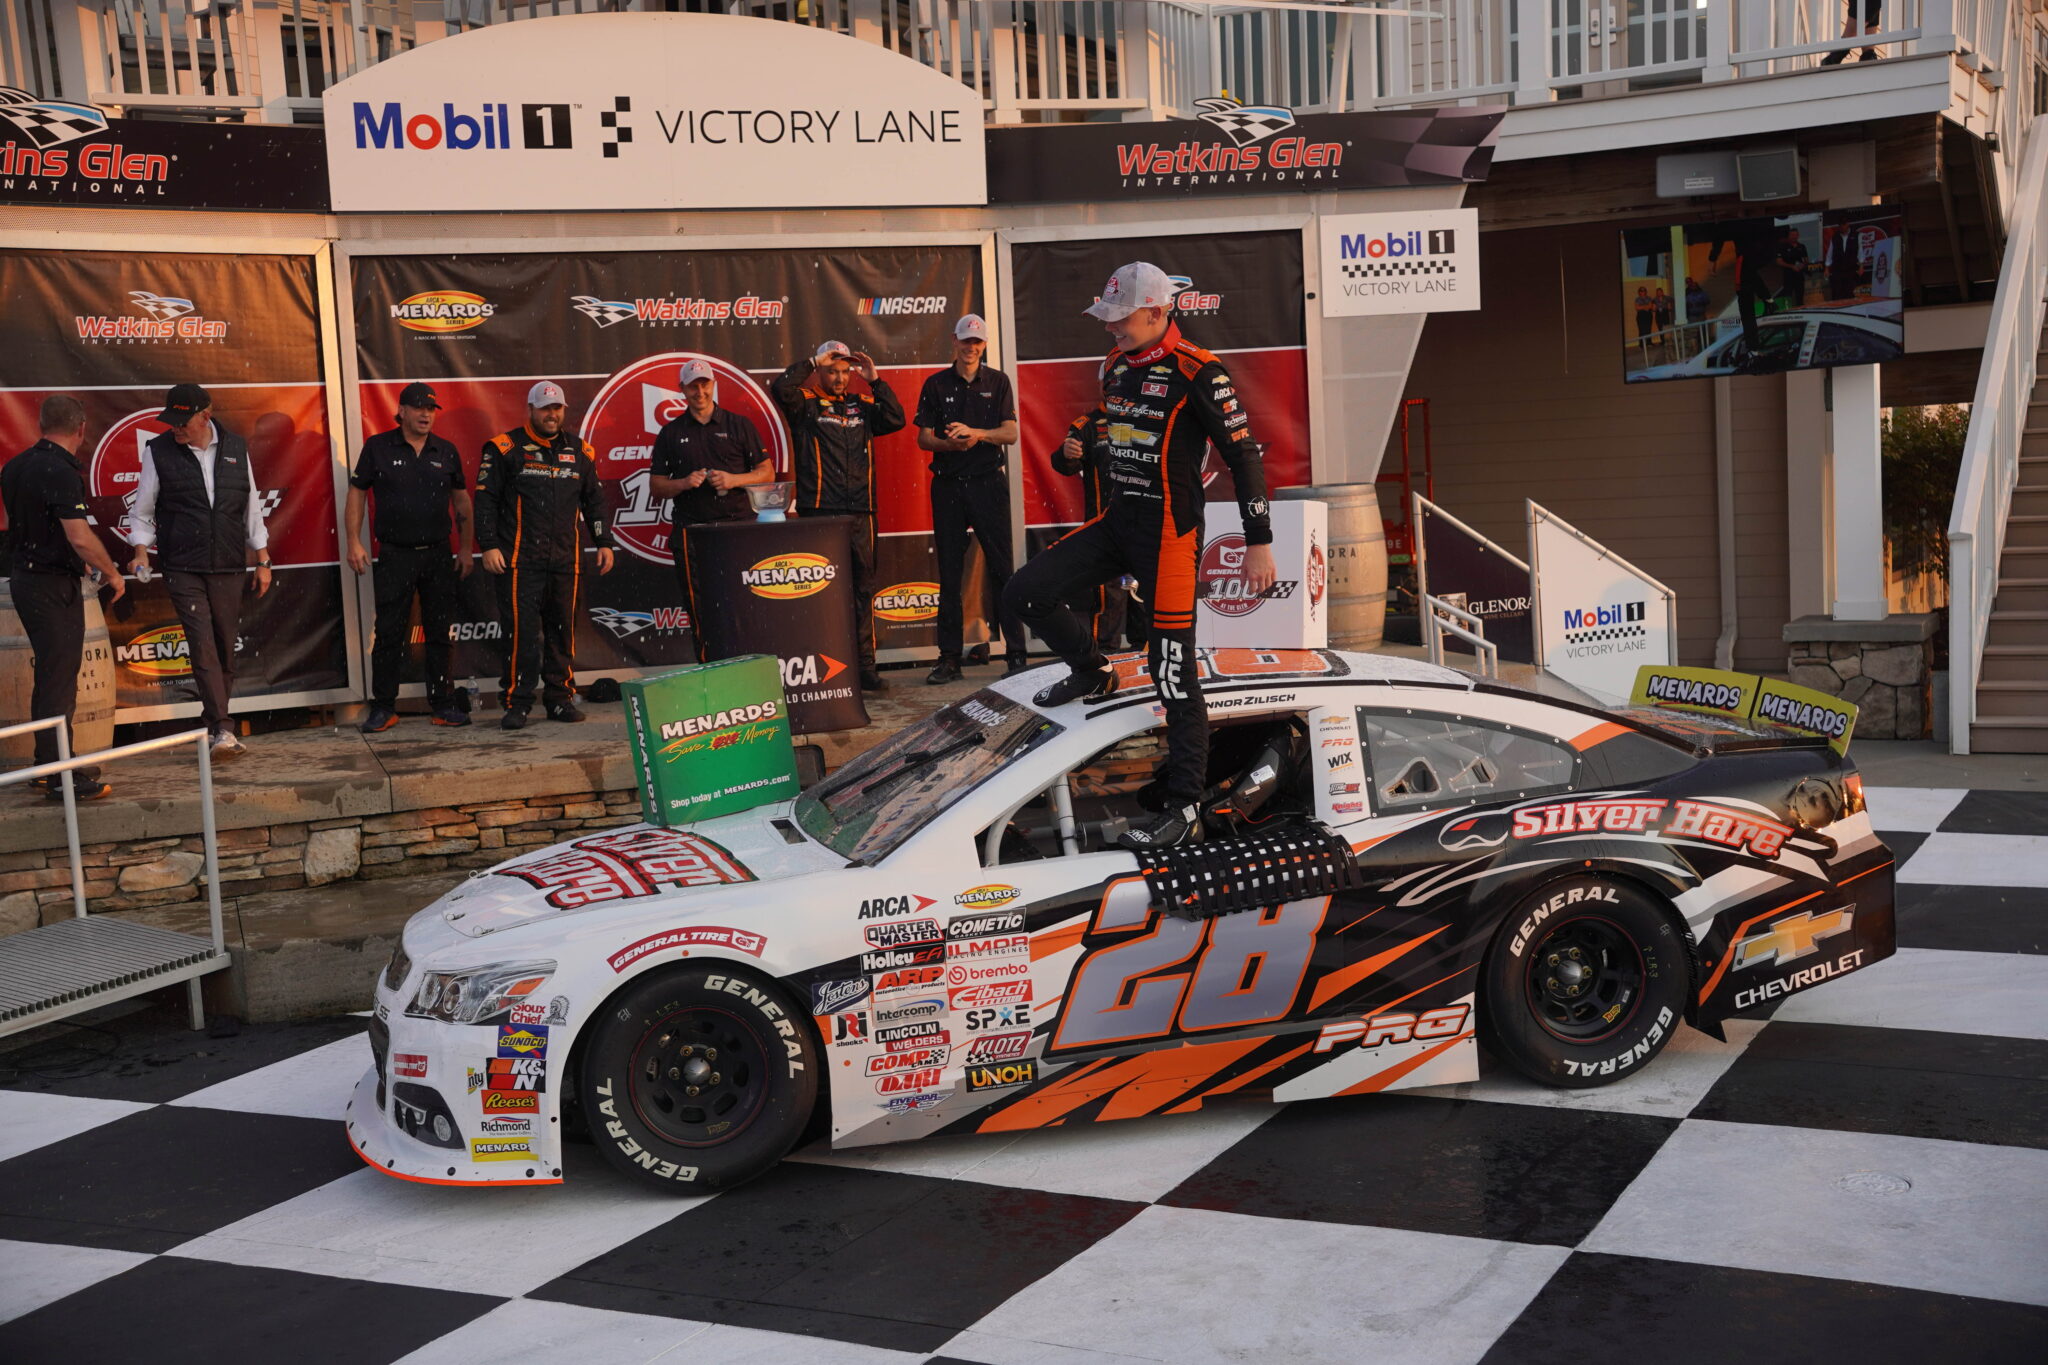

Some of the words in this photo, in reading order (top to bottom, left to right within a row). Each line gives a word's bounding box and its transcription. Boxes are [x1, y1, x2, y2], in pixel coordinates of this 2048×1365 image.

[354, 102, 510, 150] Mobil
[528, 104, 565, 148] 1
[656, 109, 840, 143] VICTORY
[855, 110, 962, 142] LANE
[79, 144, 168, 181] Glen
[1117, 142, 1261, 176] Watkins
[1268, 136, 1342, 168] Glen
[1122, 169, 1339, 188] INTERNATIONAL
[1340, 230, 1421, 260] Mobil
[1432, 230, 1450, 253] 1
[1343, 281, 1411, 297] VICTORY
[1415, 278, 1456, 293] LANE
[390, 303, 494, 318] MENARDS
[635, 298, 730, 321] Watkins
[734, 297, 783, 318] Glen
[879, 296, 947, 315] NASCAR
[1178, 292, 1221, 310] Glen
[76, 316, 174, 338] Watkins
[178, 317, 228, 337] Glen
[640, 319, 780, 327] INTERNATIONAL
[1131, 407, 1165, 418] RACING
[741, 565, 837, 586] MENARDS
[1564, 604, 1622, 630] Mobil
[1629, 602, 1643, 622] 1
[449, 621, 503, 641] ASCA
[1567, 643, 1614, 659] VICTORY
[1617, 640, 1646, 653] LANE
[801, 687, 853, 702] CHAMPIONS
[1244, 693, 1297, 705] ZILISCH
[1649, 676, 1741, 707] MENARDS
[661, 701, 778, 741] MENARDS
[1759, 694, 1848, 736] MENARDS
[666, 743, 705, 763] Save
[711, 732, 740, 750] BIG
[741, 724, 780, 745] Money
[632, 696, 658, 814] MENARDS
[1328, 752, 1353, 768] WIX
[671, 798, 690, 809] Shop
[691, 793, 712, 804] today
[713, 790, 721, 799] at
[724, 774, 790, 795] MENARDS.com
[1512, 799, 1668, 839] Silver
[1664, 799, 1794, 858] Hare
[955, 888, 1021, 905] MENARDS
[858, 896, 910, 919] ARCA
[867, 920, 935, 941] QUARTER
[949, 914, 1023, 935] COMETIC
[1510, 886, 1620, 957] GENERAL
[880, 930, 940, 947] MASTER
[948, 936, 1029, 956] ILMOR
[613, 931, 689, 969] GENERAL
[691, 931, 730, 943] TIRE
[862, 951, 914, 970] Holley
[989, 946, 1028, 955] ENGINES
[970, 963, 1028, 980] brembo
[1050, 875, 1333, 1051] 28
[875, 966, 945, 990] ARP
[875, 987, 905, 995] automotive
[921, 981, 945, 989] products
[1734, 949, 1865, 1009] CHEVROLET
[813, 979, 869, 1015] Jostens
[952, 981, 1028, 1006] Eibach
[512, 1001, 546, 1014] Sioux
[877, 1005, 937, 1021] Intercomp
[511, 1012, 542, 1025] Chief
[704, 975, 804, 1079] GENERAL
[1312, 1003, 1472, 1054] PRG
[501, 1037, 546, 1047] SUNOCO
[836, 1039, 863, 1047] shocks
[878, 1024, 937, 1042] LINCOLN
[893, 1036, 943, 1050] WELDERS
[1563, 1005, 1674, 1077] GENERAL
[974, 1035, 1027, 1056] KLOTZ
[870, 1050, 930, 1071] COMP
[514, 1075, 537, 1090] N
[880, 1068, 941, 1092] DART
[971, 1064, 1032, 1088] UNOH
[485, 1092, 535, 1108] Reese's
[889, 1096, 912, 1107] FIVE
[915, 1093, 938, 1102] STAR
[481, 1119, 530, 1131] Richmond
[597, 1077, 699, 1182] GENERAL
